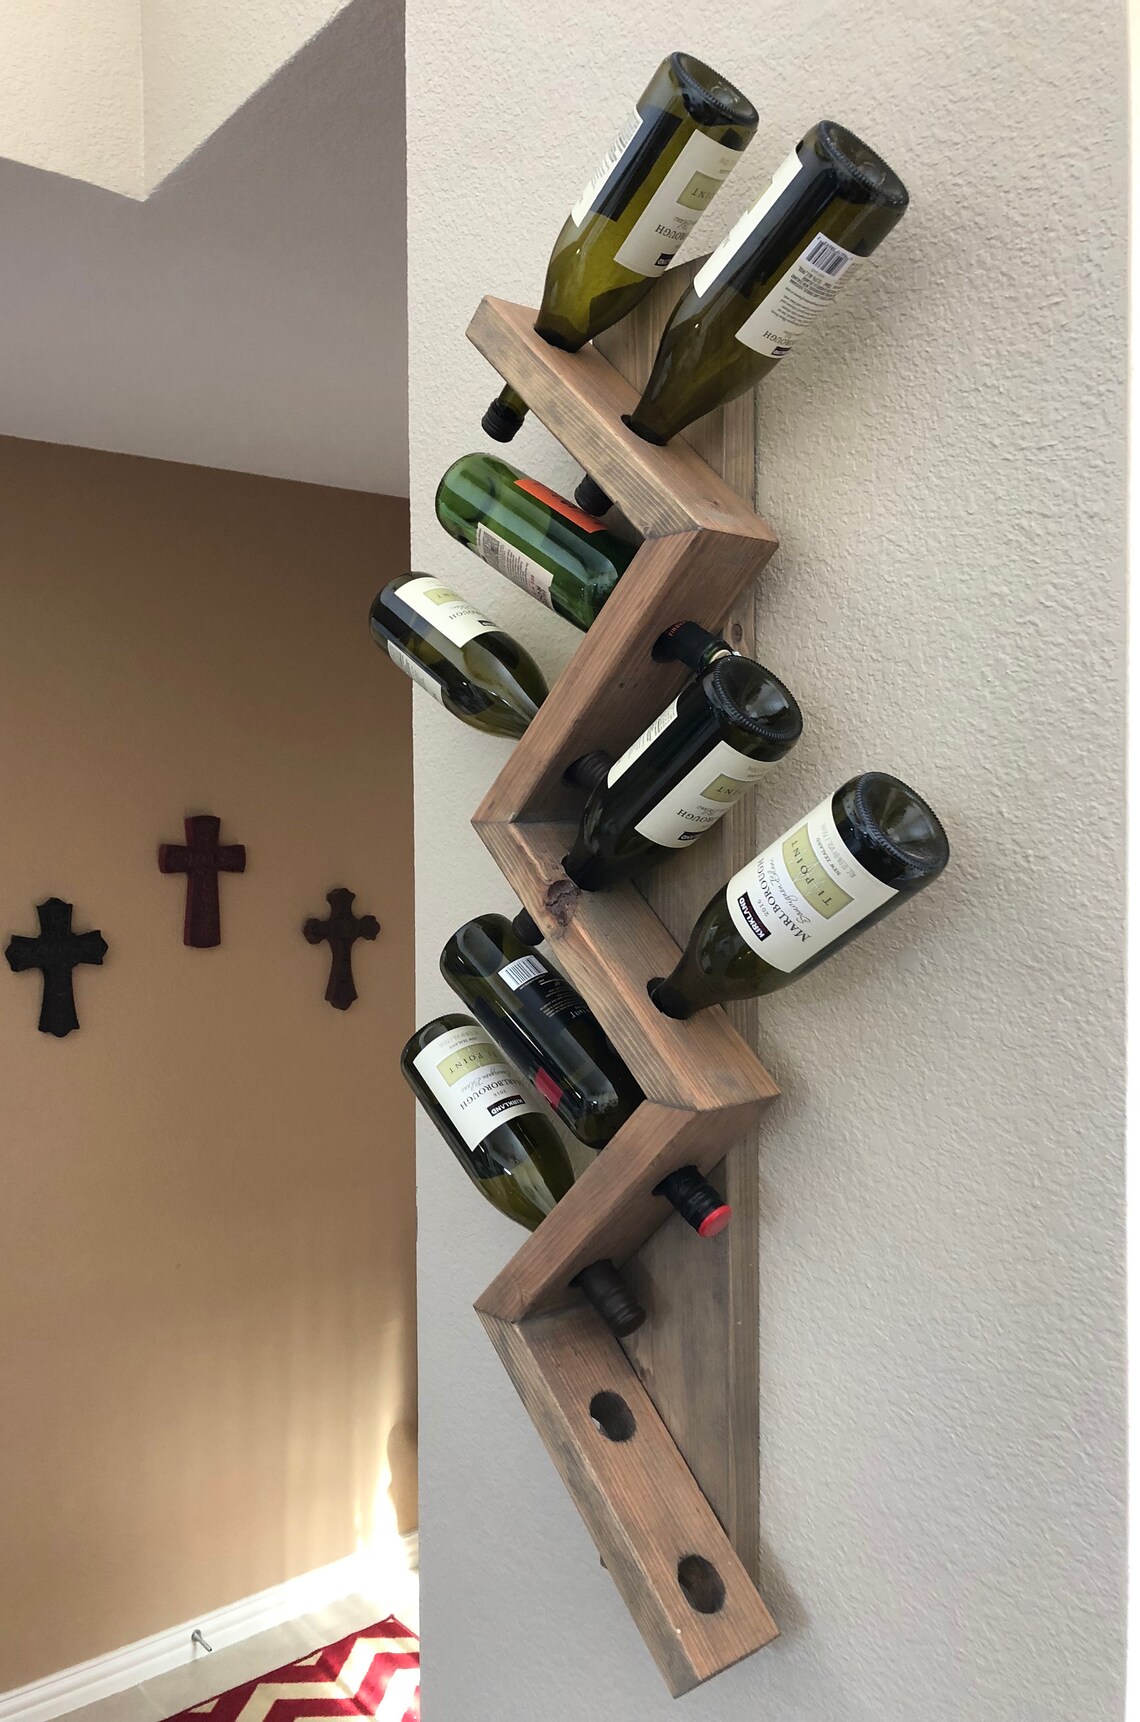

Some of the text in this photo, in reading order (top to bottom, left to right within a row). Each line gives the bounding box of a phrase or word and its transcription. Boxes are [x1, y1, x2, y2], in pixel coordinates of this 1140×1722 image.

[789, 839, 833, 906] TI POINT
[736, 896, 765, 939] KIRKLAND
[756, 857, 811, 943] MARLBOROUGH
[776, 882, 810, 924] Sauvignon
[447, 1051, 483, 1074] POINT
[489, 1097, 523, 1115] KIRKLAND
